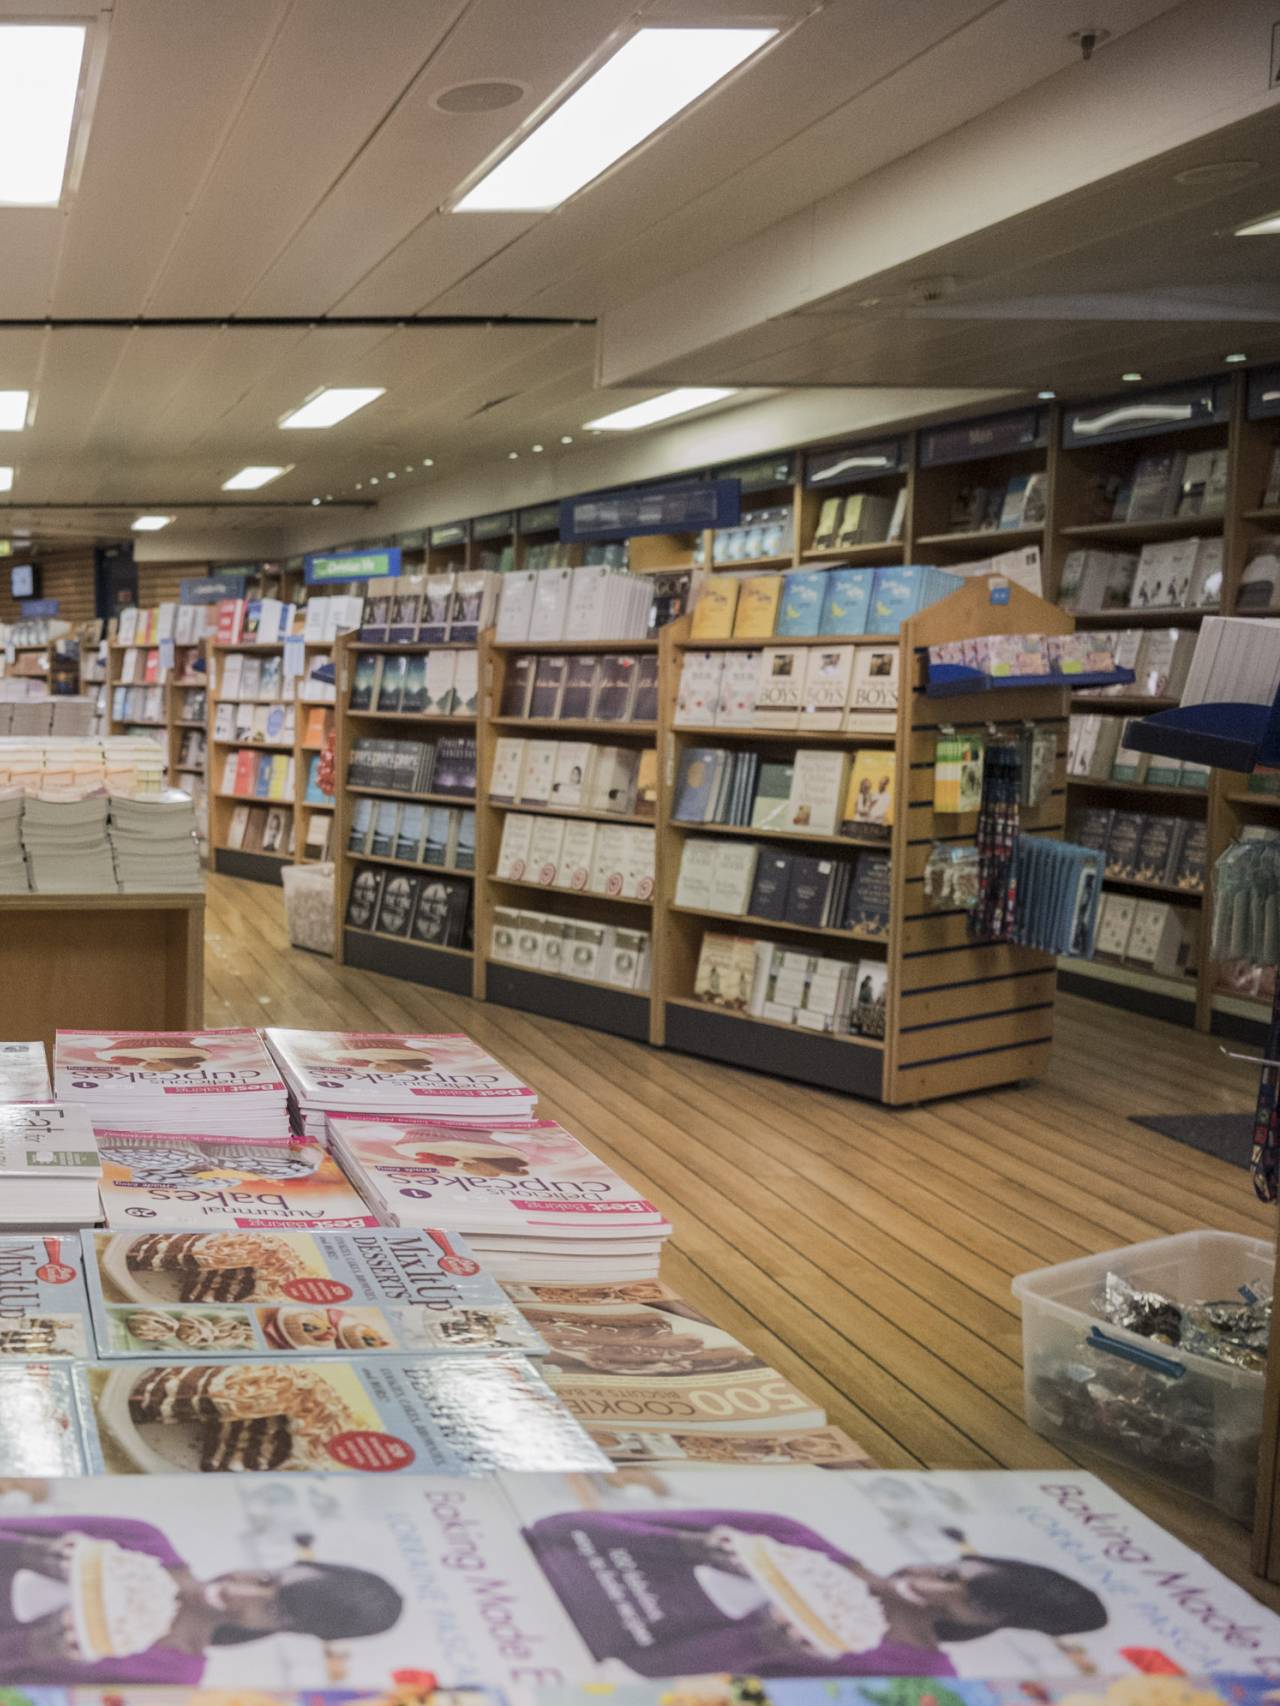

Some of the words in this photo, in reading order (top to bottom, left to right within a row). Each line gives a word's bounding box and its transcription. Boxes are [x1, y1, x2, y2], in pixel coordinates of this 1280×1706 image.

[71, 1069, 262, 1085] cupcakes
[149, 1078, 247, 1086] Delicious
[308, 1071, 500, 1084] cupcakes
[175, 1085, 227, 1094] Baking
[229, 1083, 275, 1092] Best
[392, 1081, 491, 1089] Delicious
[422, 1088, 476, 1096] Baking
[387, 1173, 612, 1194] cupcakes
[147, 1190, 289, 1210] bakes
[485, 1189, 603, 1200] Delicious
[524, 1200, 586, 1212] Baking
[588, 1202, 645, 1213] Best
[201, 1207, 325, 1218] Autumnal
[247, 1218, 308, 1228] Baking
[314, 1218, 366, 1228] Best
[352, 1236, 412, 1300] DESSERTS
[384, 1237, 433, 1270] Mix
[409, 1285, 462, 1312] Up
[0, 1278, 39, 1295] It
[688, 1382, 809, 1417] 500
[571, 1400, 696, 1416] COOKIE
[1040, 1482, 1152, 1565] Baking
[1143, 1565, 1262, 1651] Made
[423, 1489, 487, 1575] Baking
[462, 1574, 535, 1661] Made
